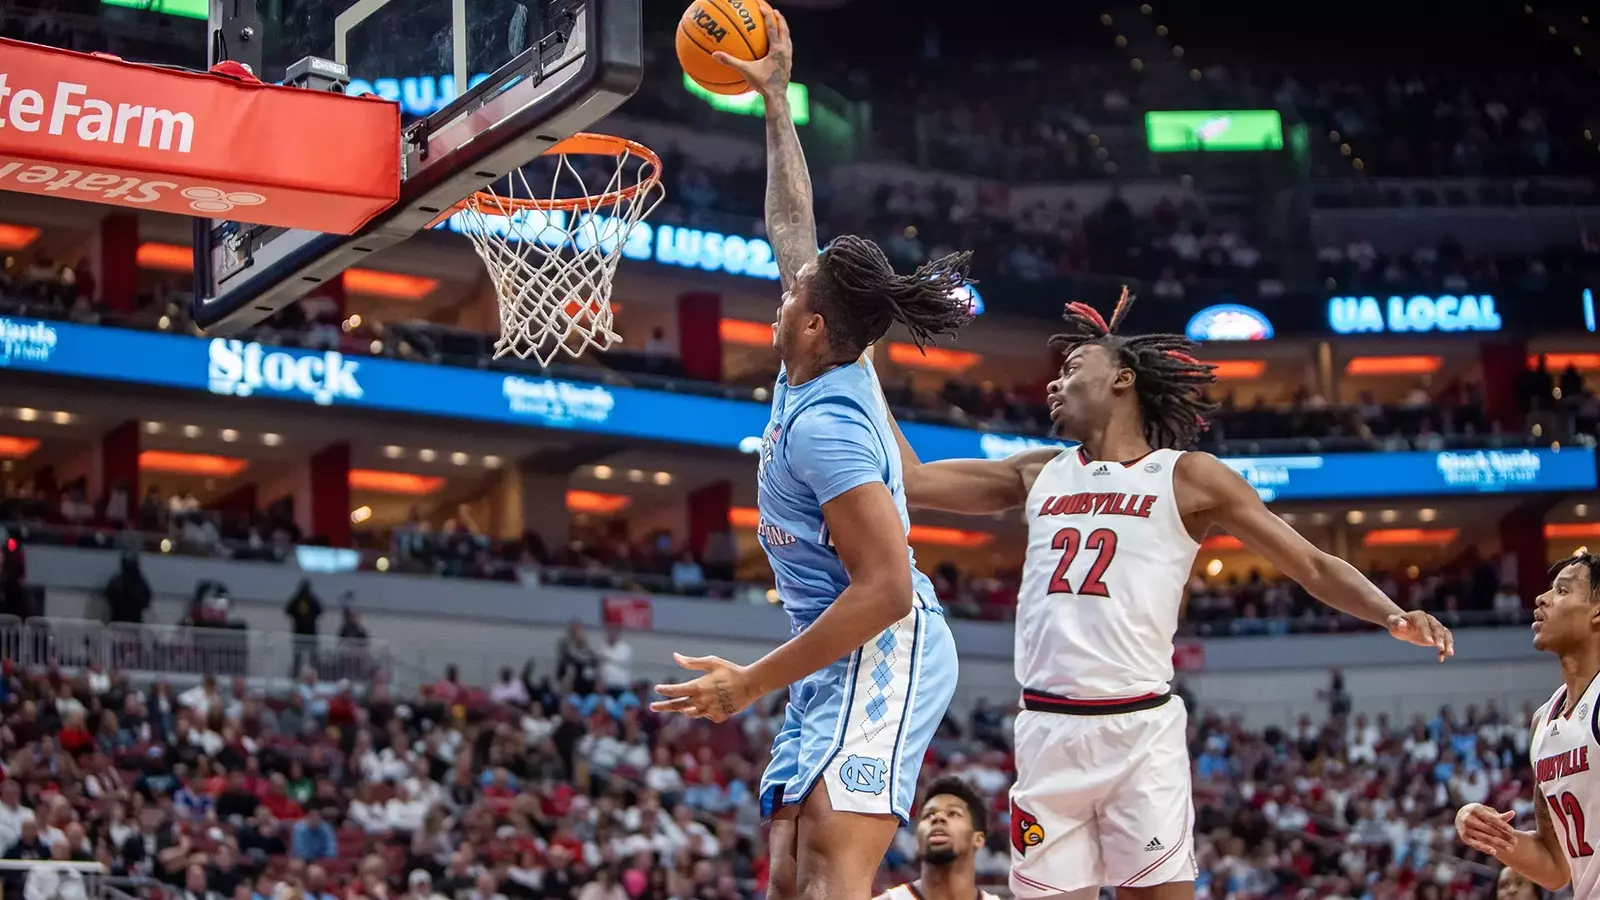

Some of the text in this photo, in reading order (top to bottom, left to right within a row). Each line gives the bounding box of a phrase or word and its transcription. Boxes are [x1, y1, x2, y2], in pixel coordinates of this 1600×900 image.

[692, 7, 727, 43] NCAA
[728, 0, 757, 32] son
[1328, 295, 1502, 333] UA LOCAL
[207, 337, 364, 400] Stock
[1038, 492, 1158, 518] LOUISVILLE
[1047, 527, 1118, 598] 22
[1534, 745, 1589, 782] OUISVILLE
[1546, 791, 1594, 858] 12
